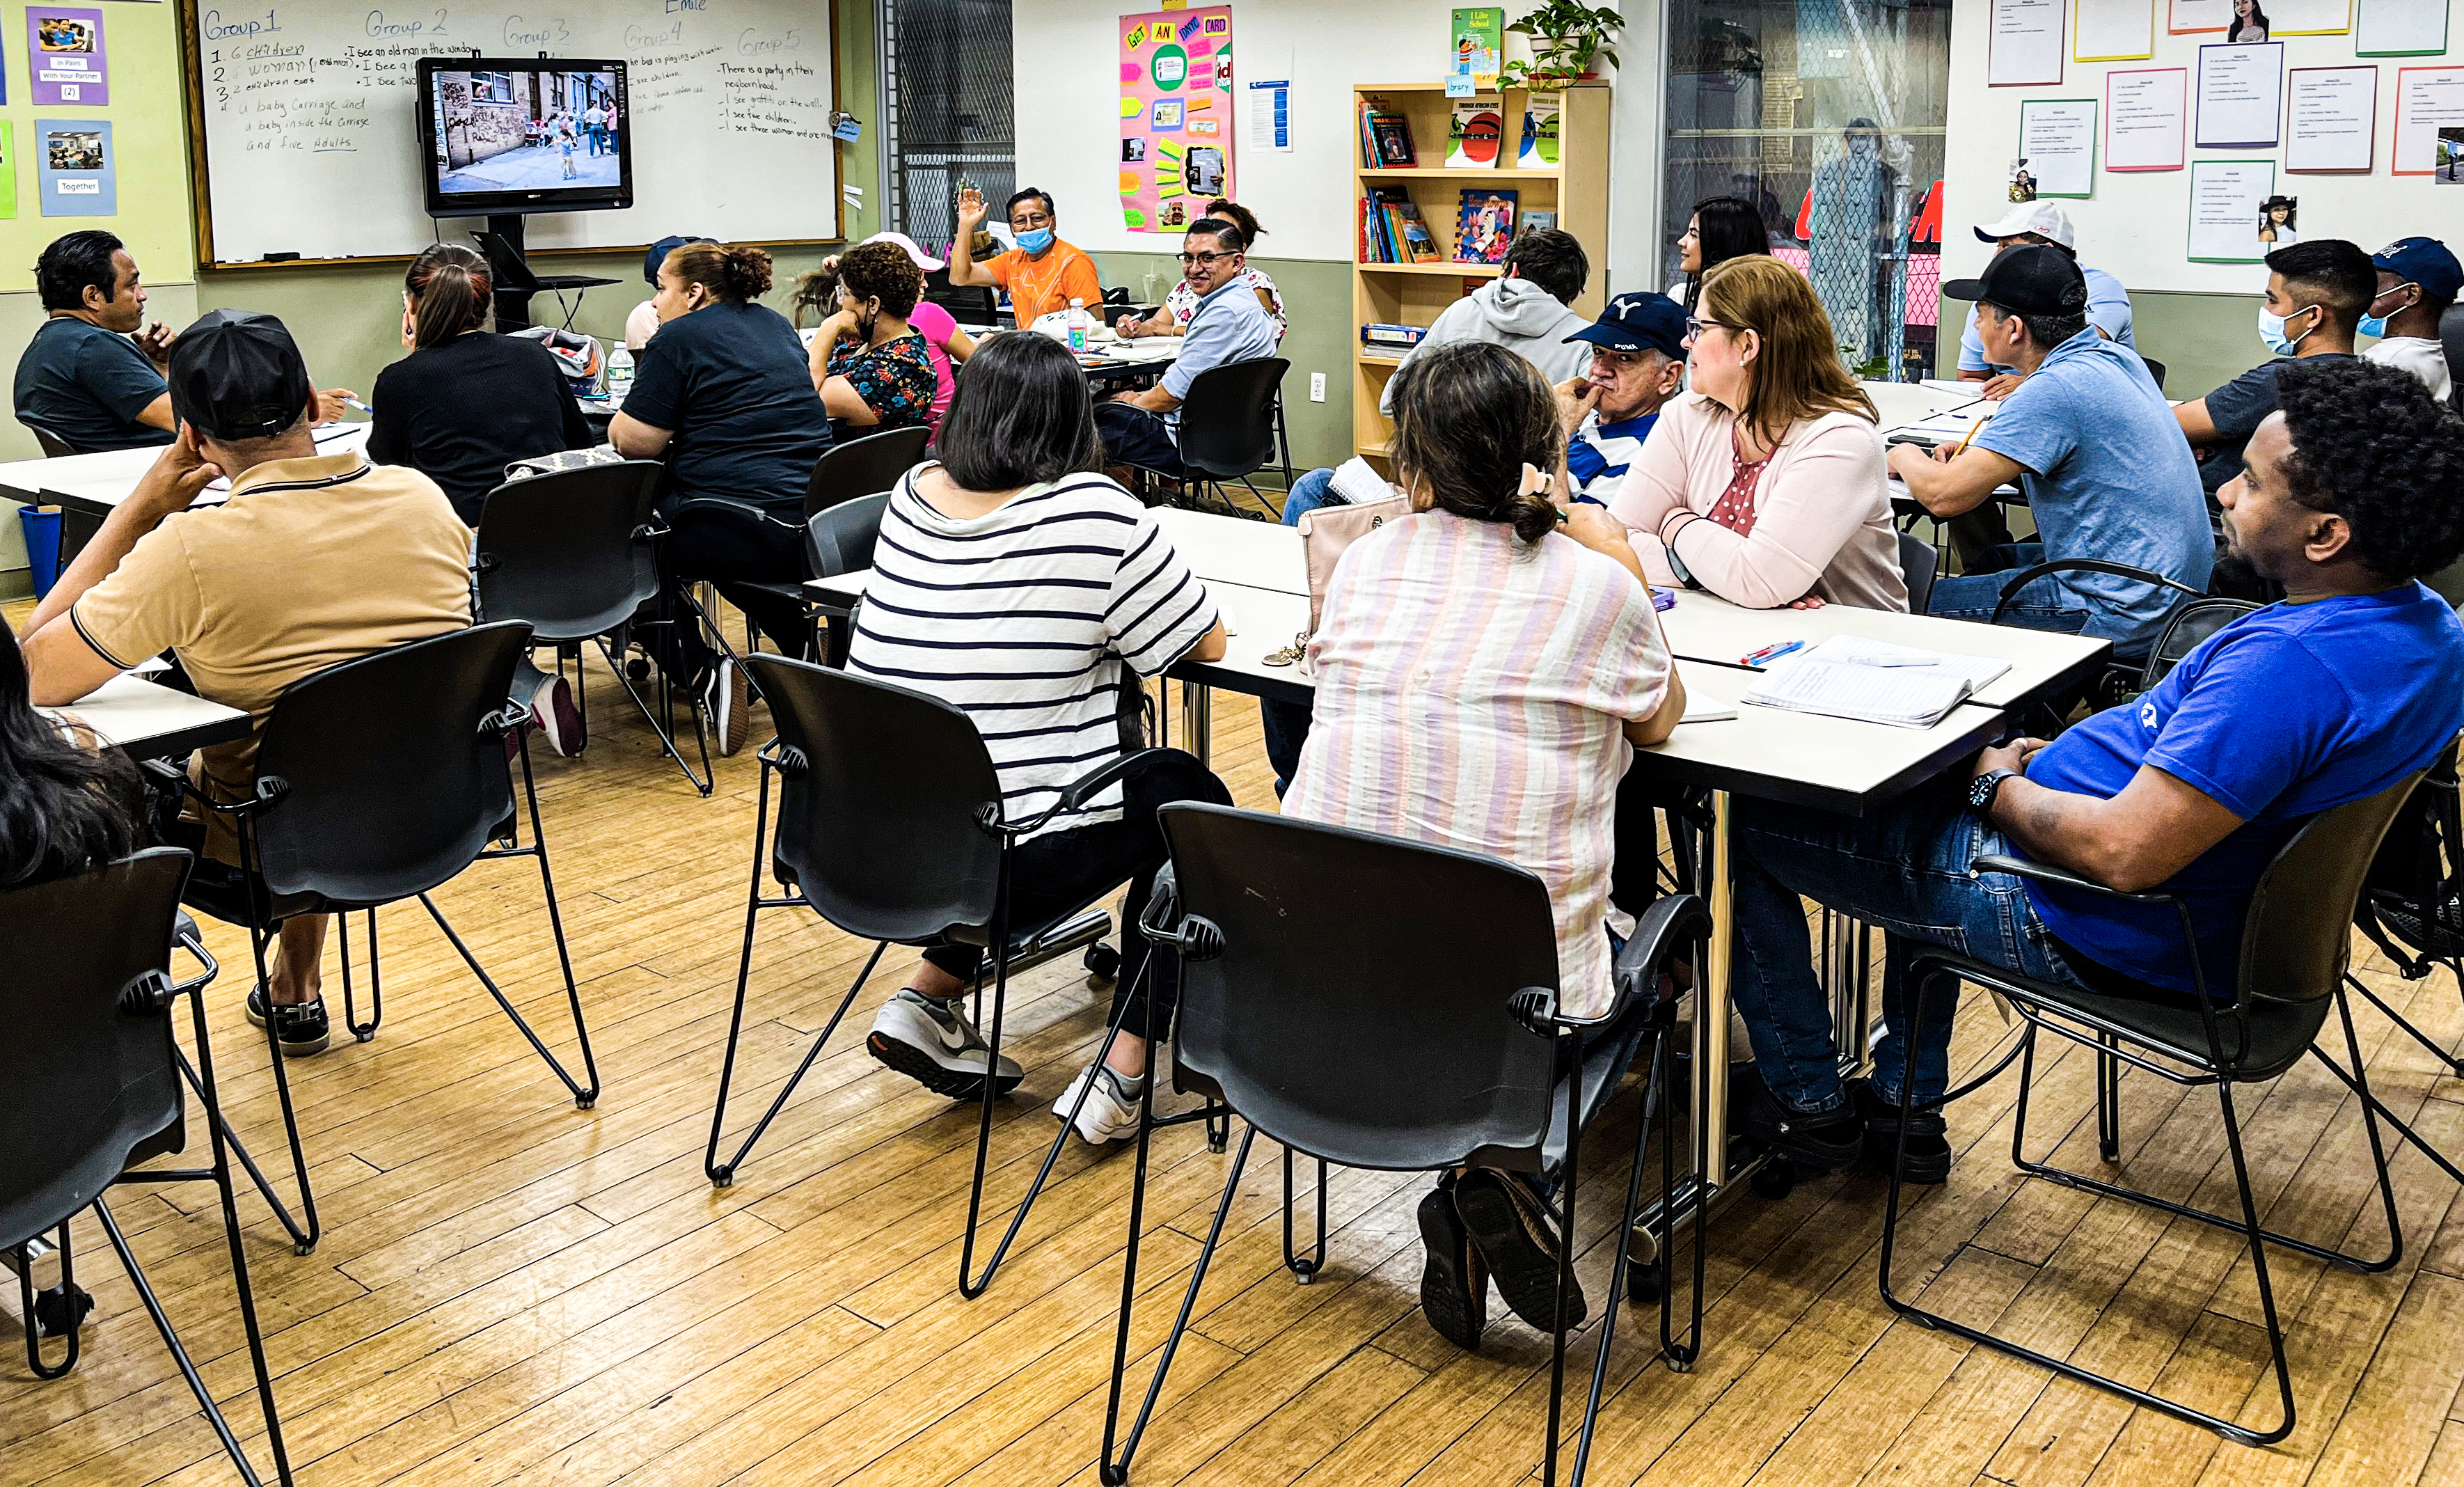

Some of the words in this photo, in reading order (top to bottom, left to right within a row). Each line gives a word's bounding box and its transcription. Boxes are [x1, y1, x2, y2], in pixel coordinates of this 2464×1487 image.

[205, 10, 260, 40] Group
[264, 9, 282, 30] 1
[366, 10, 422, 38] Group
[434, 8, 448, 31] 2
[504, 15, 550, 47] Group
[554, 18, 570, 41] 3
[1469, 19, 1490, 28] School
[624, 24, 668, 49] Group
[671, 21, 681, 40] 4
[1128, 26, 1144, 48] GET
[1156, 25, 1171, 40] AN
[1205, 18, 1226, 33] CARD
[738, 28, 782, 56] Group
[785, 29, 800, 47] 5
[231, 46, 240, 59] 6
[375, 49, 385, 59] an
[388, 43, 400, 56] old
[429, 42, 444, 54] the
[448, 42, 475, 54] windo
[375, 62, 396, 70] see
[765, 63, 784, 81] party
[378, 77, 396, 86] see
[257, 100, 287, 117] baby
[790, 97, 803, 107] the
[258, 120, 281, 133] baby
[285, 118, 314, 128] inside
[319, 117, 332, 126] the
[750, 123, 768, 133] three
[247, 139, 271, 151] and
[280, 136, 303, 149] five
[314, 139, 351, 148] Adults
[61, 182, 96, 191] Together
